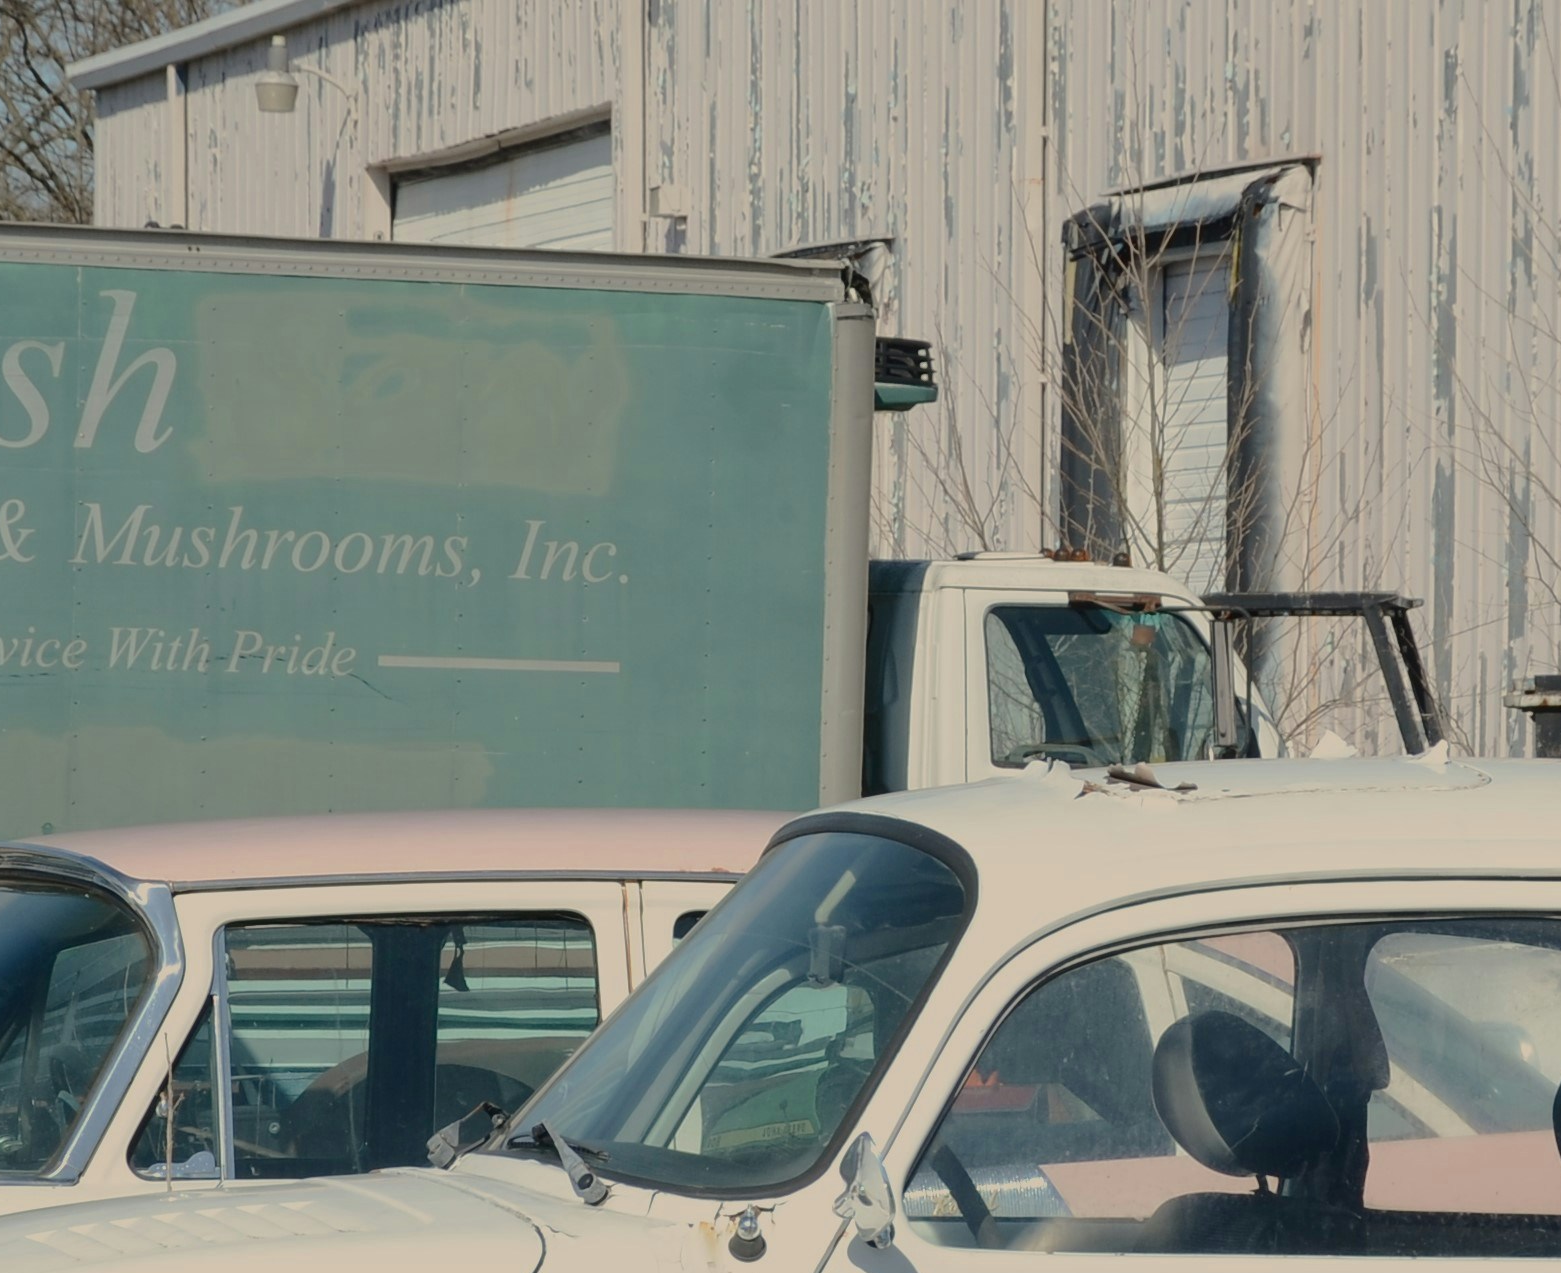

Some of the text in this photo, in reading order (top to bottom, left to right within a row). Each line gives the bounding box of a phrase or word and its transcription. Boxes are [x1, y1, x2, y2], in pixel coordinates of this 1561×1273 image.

[68, 501, 482, 588] Mushrooms,
[508, 519, 630, 585] Inc.
[107, 625, 210, 672] With
[225, 629, 358, 676] Pride
